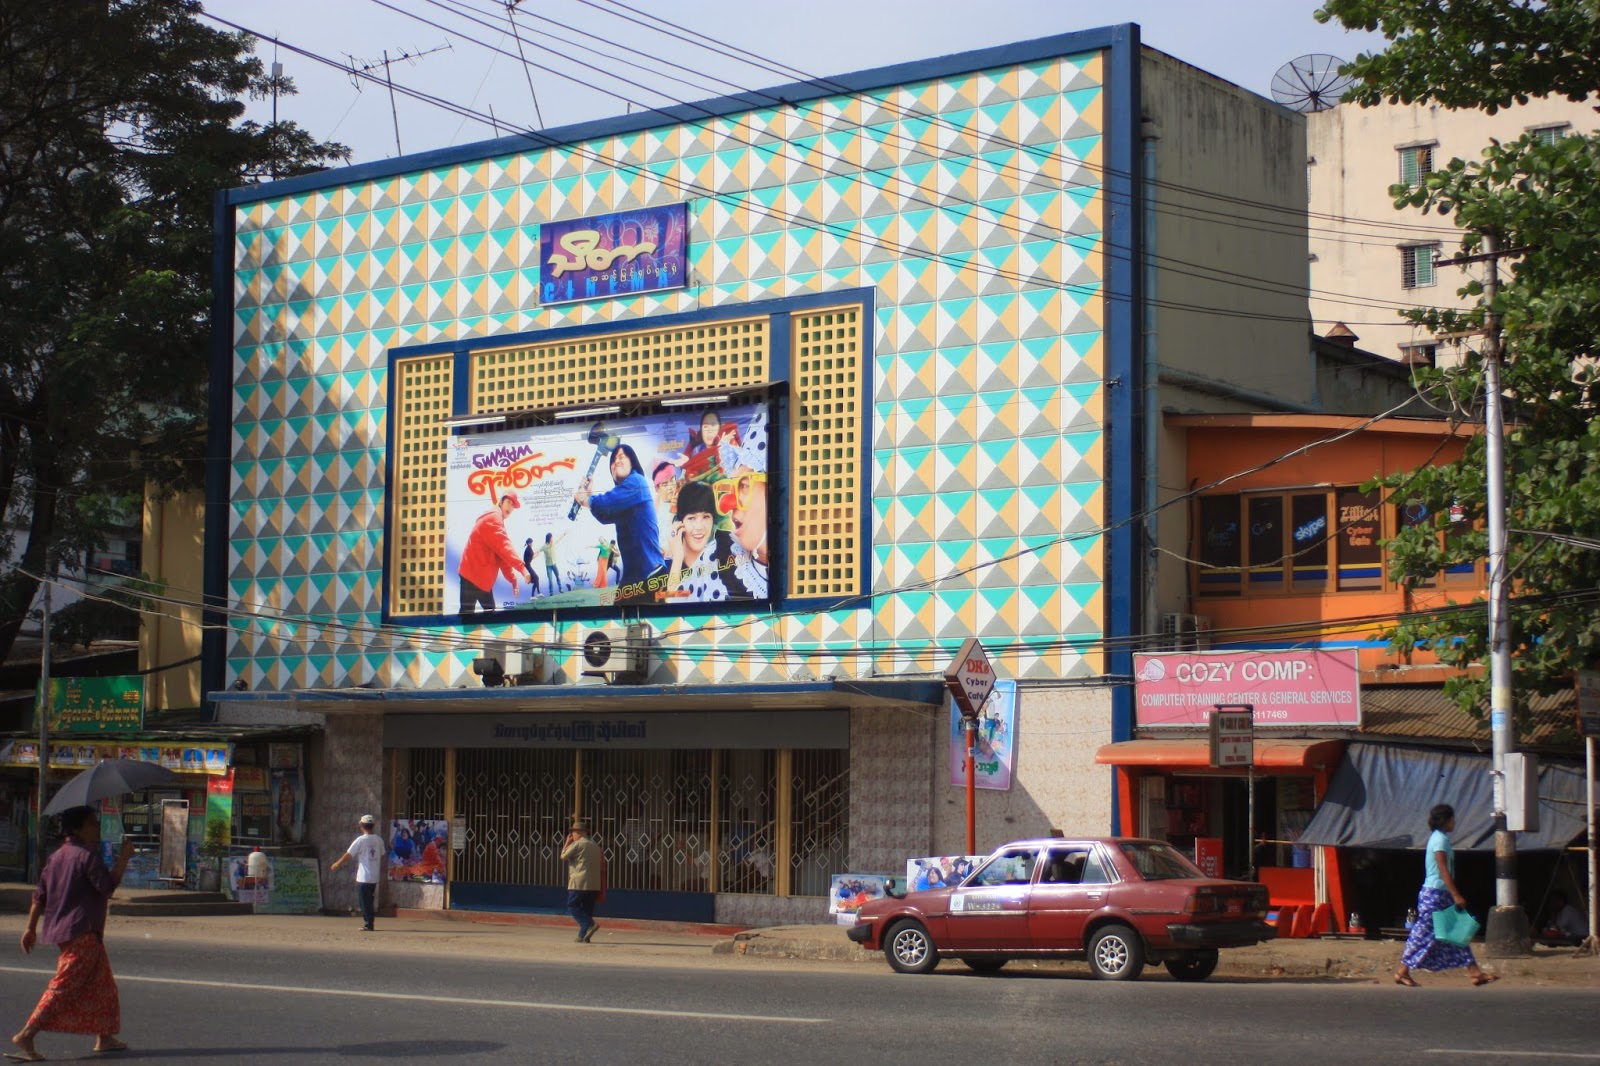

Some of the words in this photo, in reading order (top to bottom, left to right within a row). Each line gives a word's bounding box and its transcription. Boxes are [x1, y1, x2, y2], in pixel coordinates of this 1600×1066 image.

[544, 268, 669, 302] CINEMA
[600, 581, 646, 605] ROCK
[966, 659, 989, 674] DK's
[1176, 662, 1235, 682] COZY
[1241, 660, 1313, 681] COMP:
[966, 677, 988, 687] Cyber
[1141, 693, 1186, 707] COMPUTER
[1187, 692, 1226, 706] TRAINING
[1227, 692, 1260, 705] CENTER
[1261, 692, 1267, 704] &
[1269, 691, 1309, 704] GENERAL
[1311, 690, 1352, 704] SERVICES
